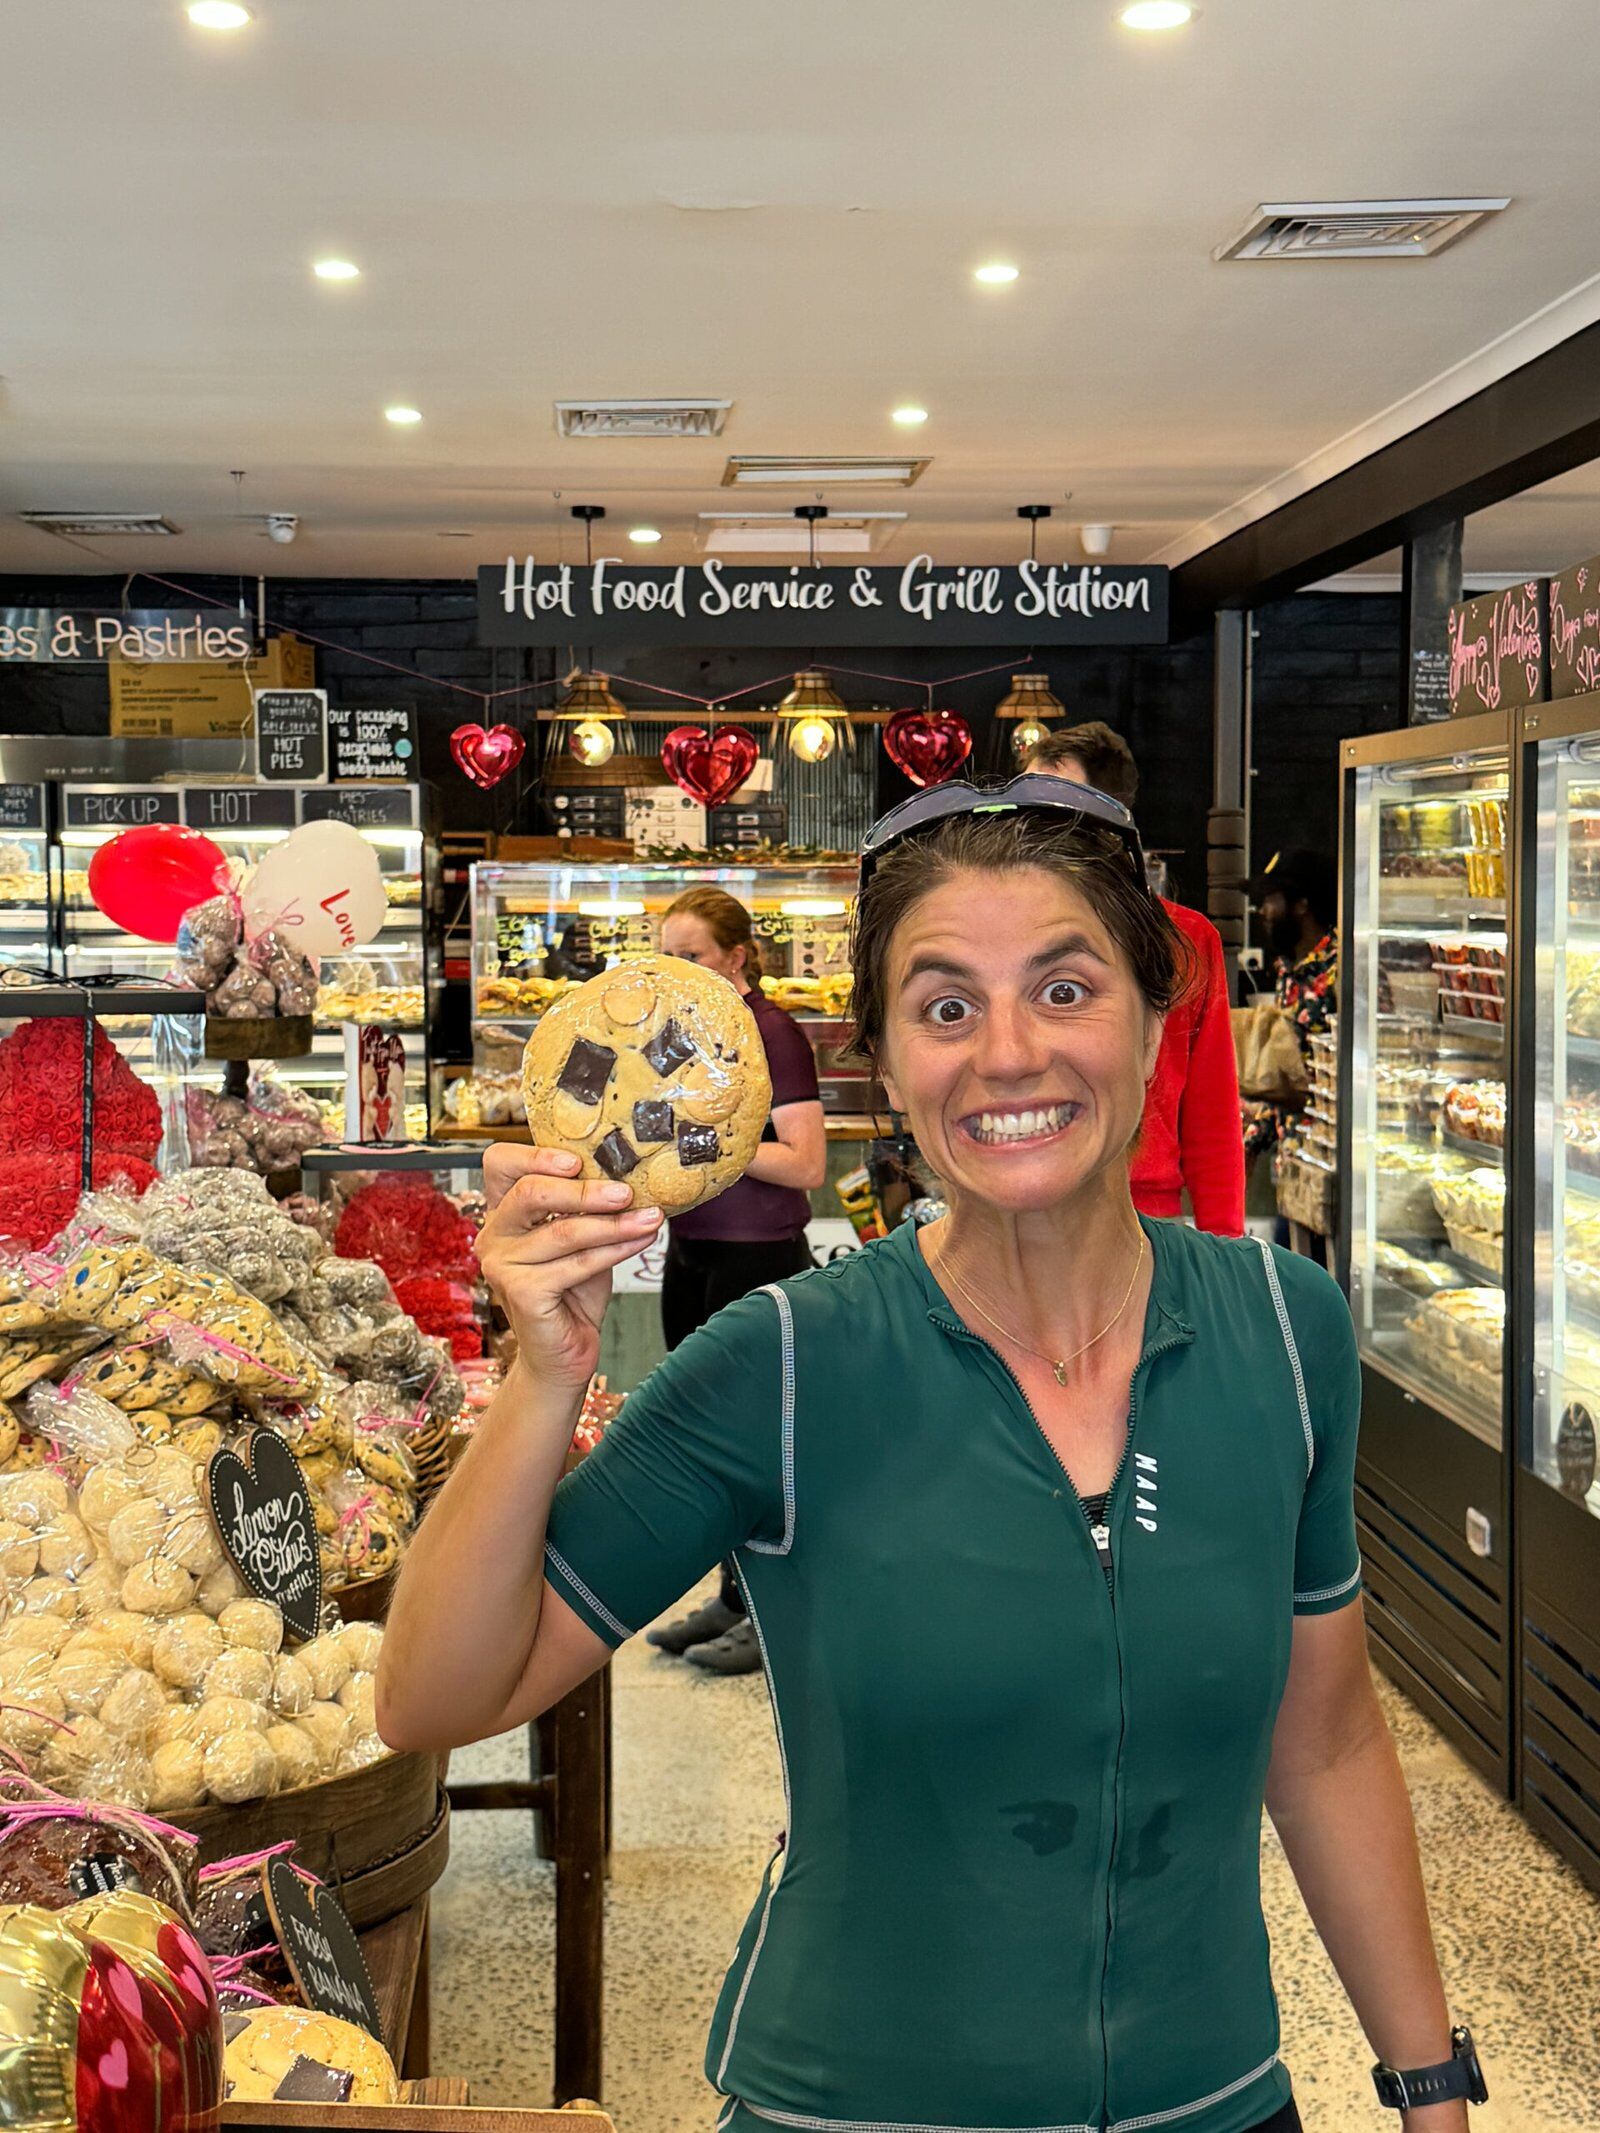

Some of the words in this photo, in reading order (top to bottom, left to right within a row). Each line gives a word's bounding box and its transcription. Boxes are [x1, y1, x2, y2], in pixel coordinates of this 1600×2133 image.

[500, 556, 576, 620] Hot
[591, 558, 686, 618] Food
[700, 559, 834, 616] Service
[850, 567, 883, 607] &
[900, 554, 1003, 620] Grill
[1015, 559, 1149, 617] Station
[51, 615, 82, 657] &
[95, 613, 250, 658] Pastries
[355, 708, 408, 732] packaging
[273, 736, 305, 752] HOT
[356, 724, 388, 741] 100%
[270, 753, 304, 769] PIES
[338, 742, 394, 758] Recyclable
[338, 760, 408, 778] Biodegradable
[83, 797, 126, 823] PICK
[131, 797, 160, 823] UP
[209, 792, 259, 823] HOT
[1134, 1452, 1158, 1533] MAAP
